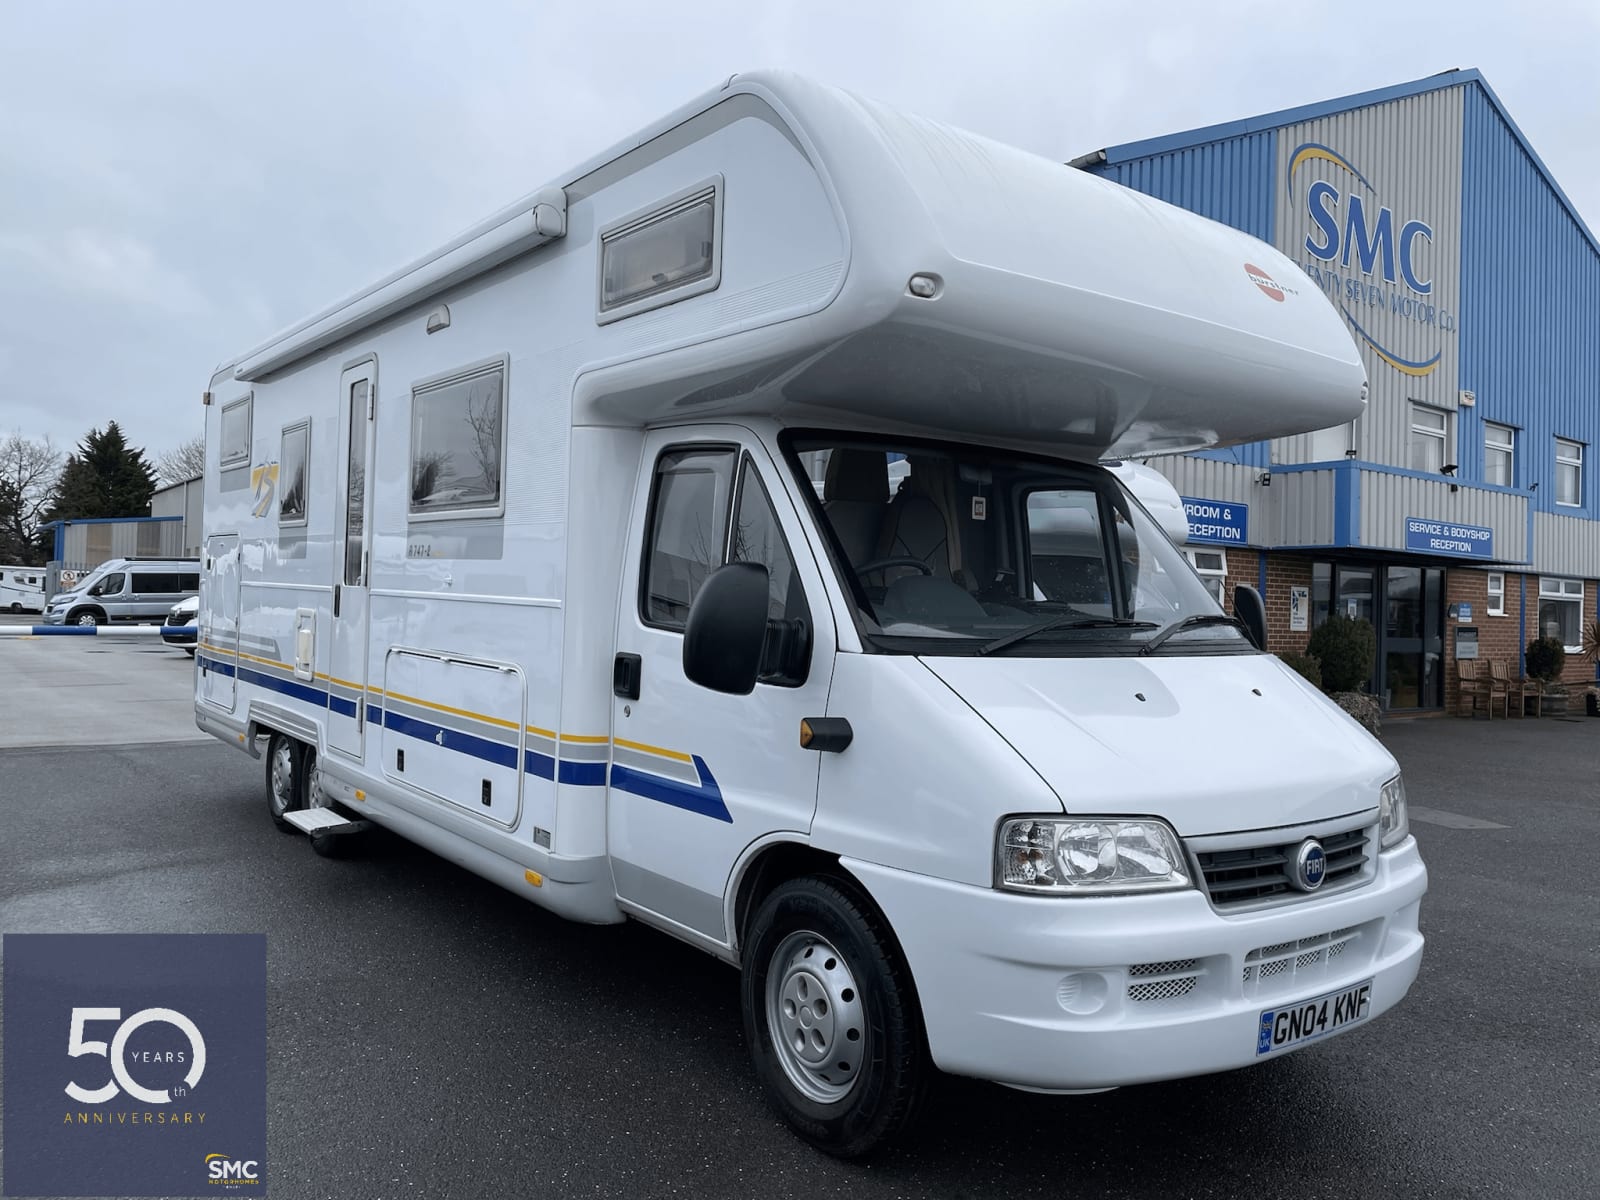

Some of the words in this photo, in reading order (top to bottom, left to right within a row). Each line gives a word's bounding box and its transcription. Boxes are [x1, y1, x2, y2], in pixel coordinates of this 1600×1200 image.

[1304, 180, 1433, 296] SMC
[1290, 258, 1341, 296] ENTY
[1345, 278, 1384, 309] SEVEN
[1391, 293, 1436, 328] MOTOR
[1182, 503, 1220, 519] ROOM
[1223, 508, 1232, 520] &
[1409, 521, 1442, 535] SERVICE
[1443, 526, 1450, 536] &
[1451, 527, 1490, 541] BODYSHOP
[1430, 538, 1472, 553] RECEPTION
[1306, 857, 1324, 876] FIAT
[1273, 1000, 1328, 1045] GN04
[1332, 985, 1369, 1027] KNF
[1259, 1038, 1270, 1049] UK
